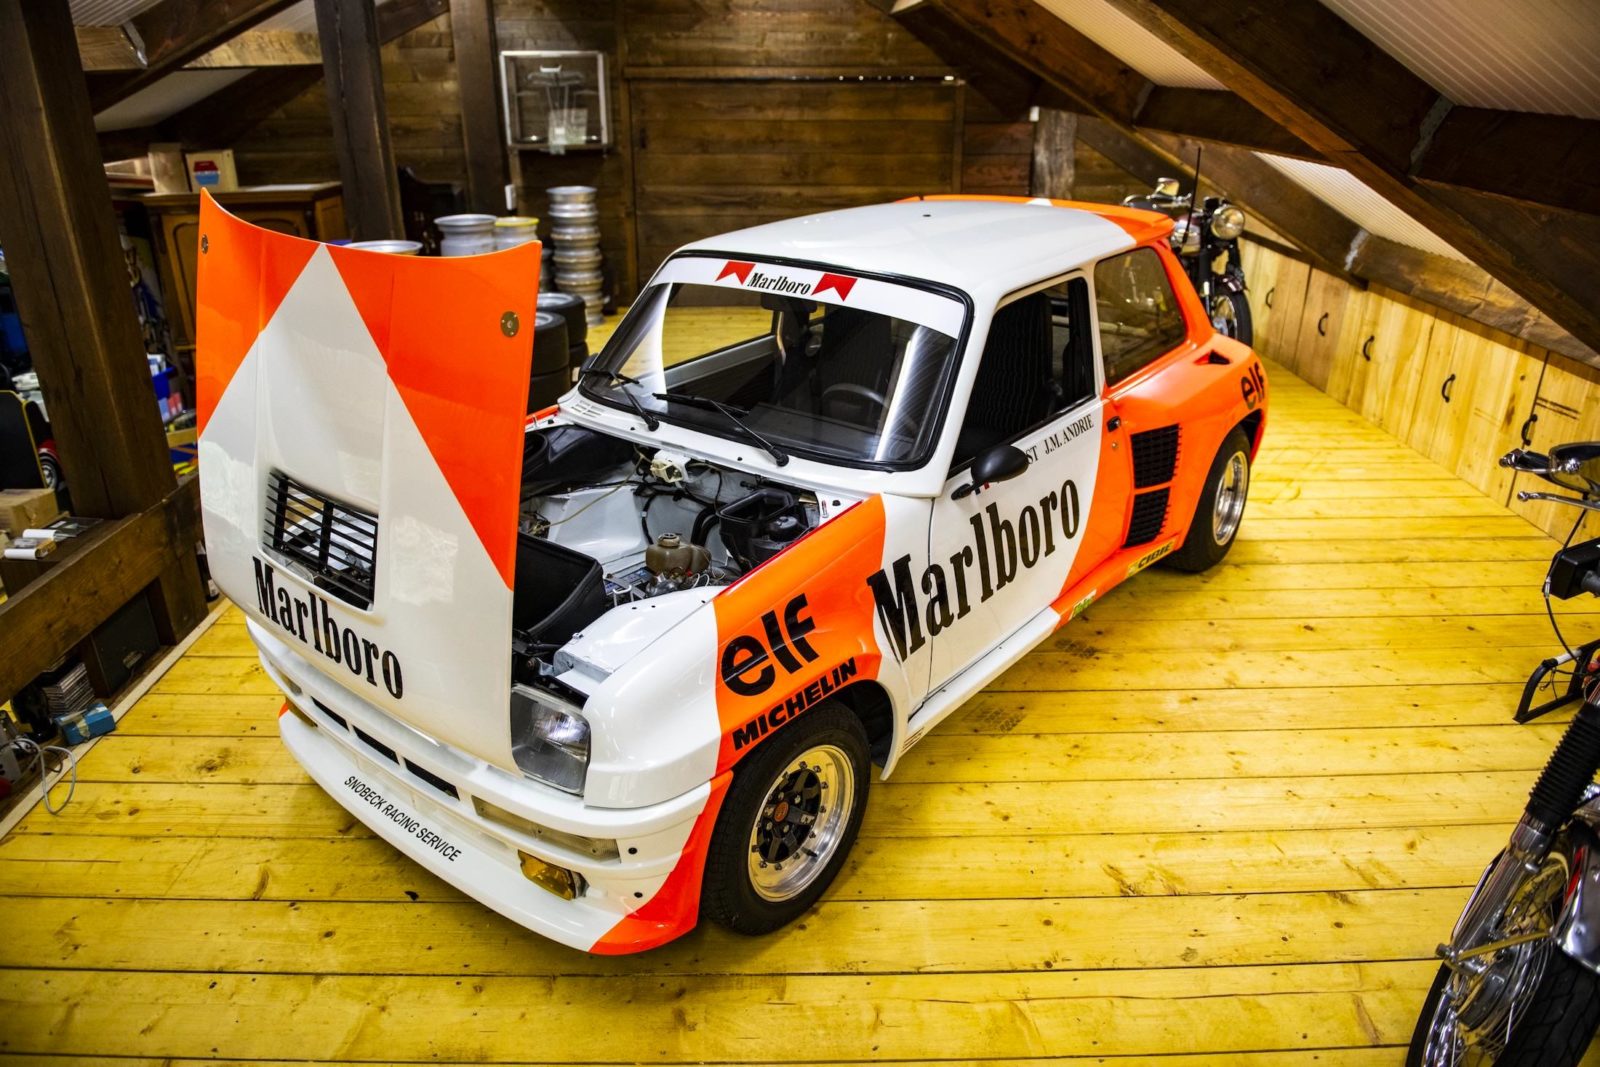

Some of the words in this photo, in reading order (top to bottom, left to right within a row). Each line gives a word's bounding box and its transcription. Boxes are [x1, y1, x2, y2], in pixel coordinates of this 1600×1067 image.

[747, 272, 811, 295] Marlboro
[1241, 362, 1265, 410] elf
[866, 479, 1080, 665] Marlboro
[252, 556, 403, 700] Marlboro
[721, 593, 820, 697] elf
[732, 657, 858, 751] MICHELIN
[344, 776, 387, 810] SNOBECK
[381, 804, 420, 834] RACING
[416, 827, 462, 862] SERVICE
